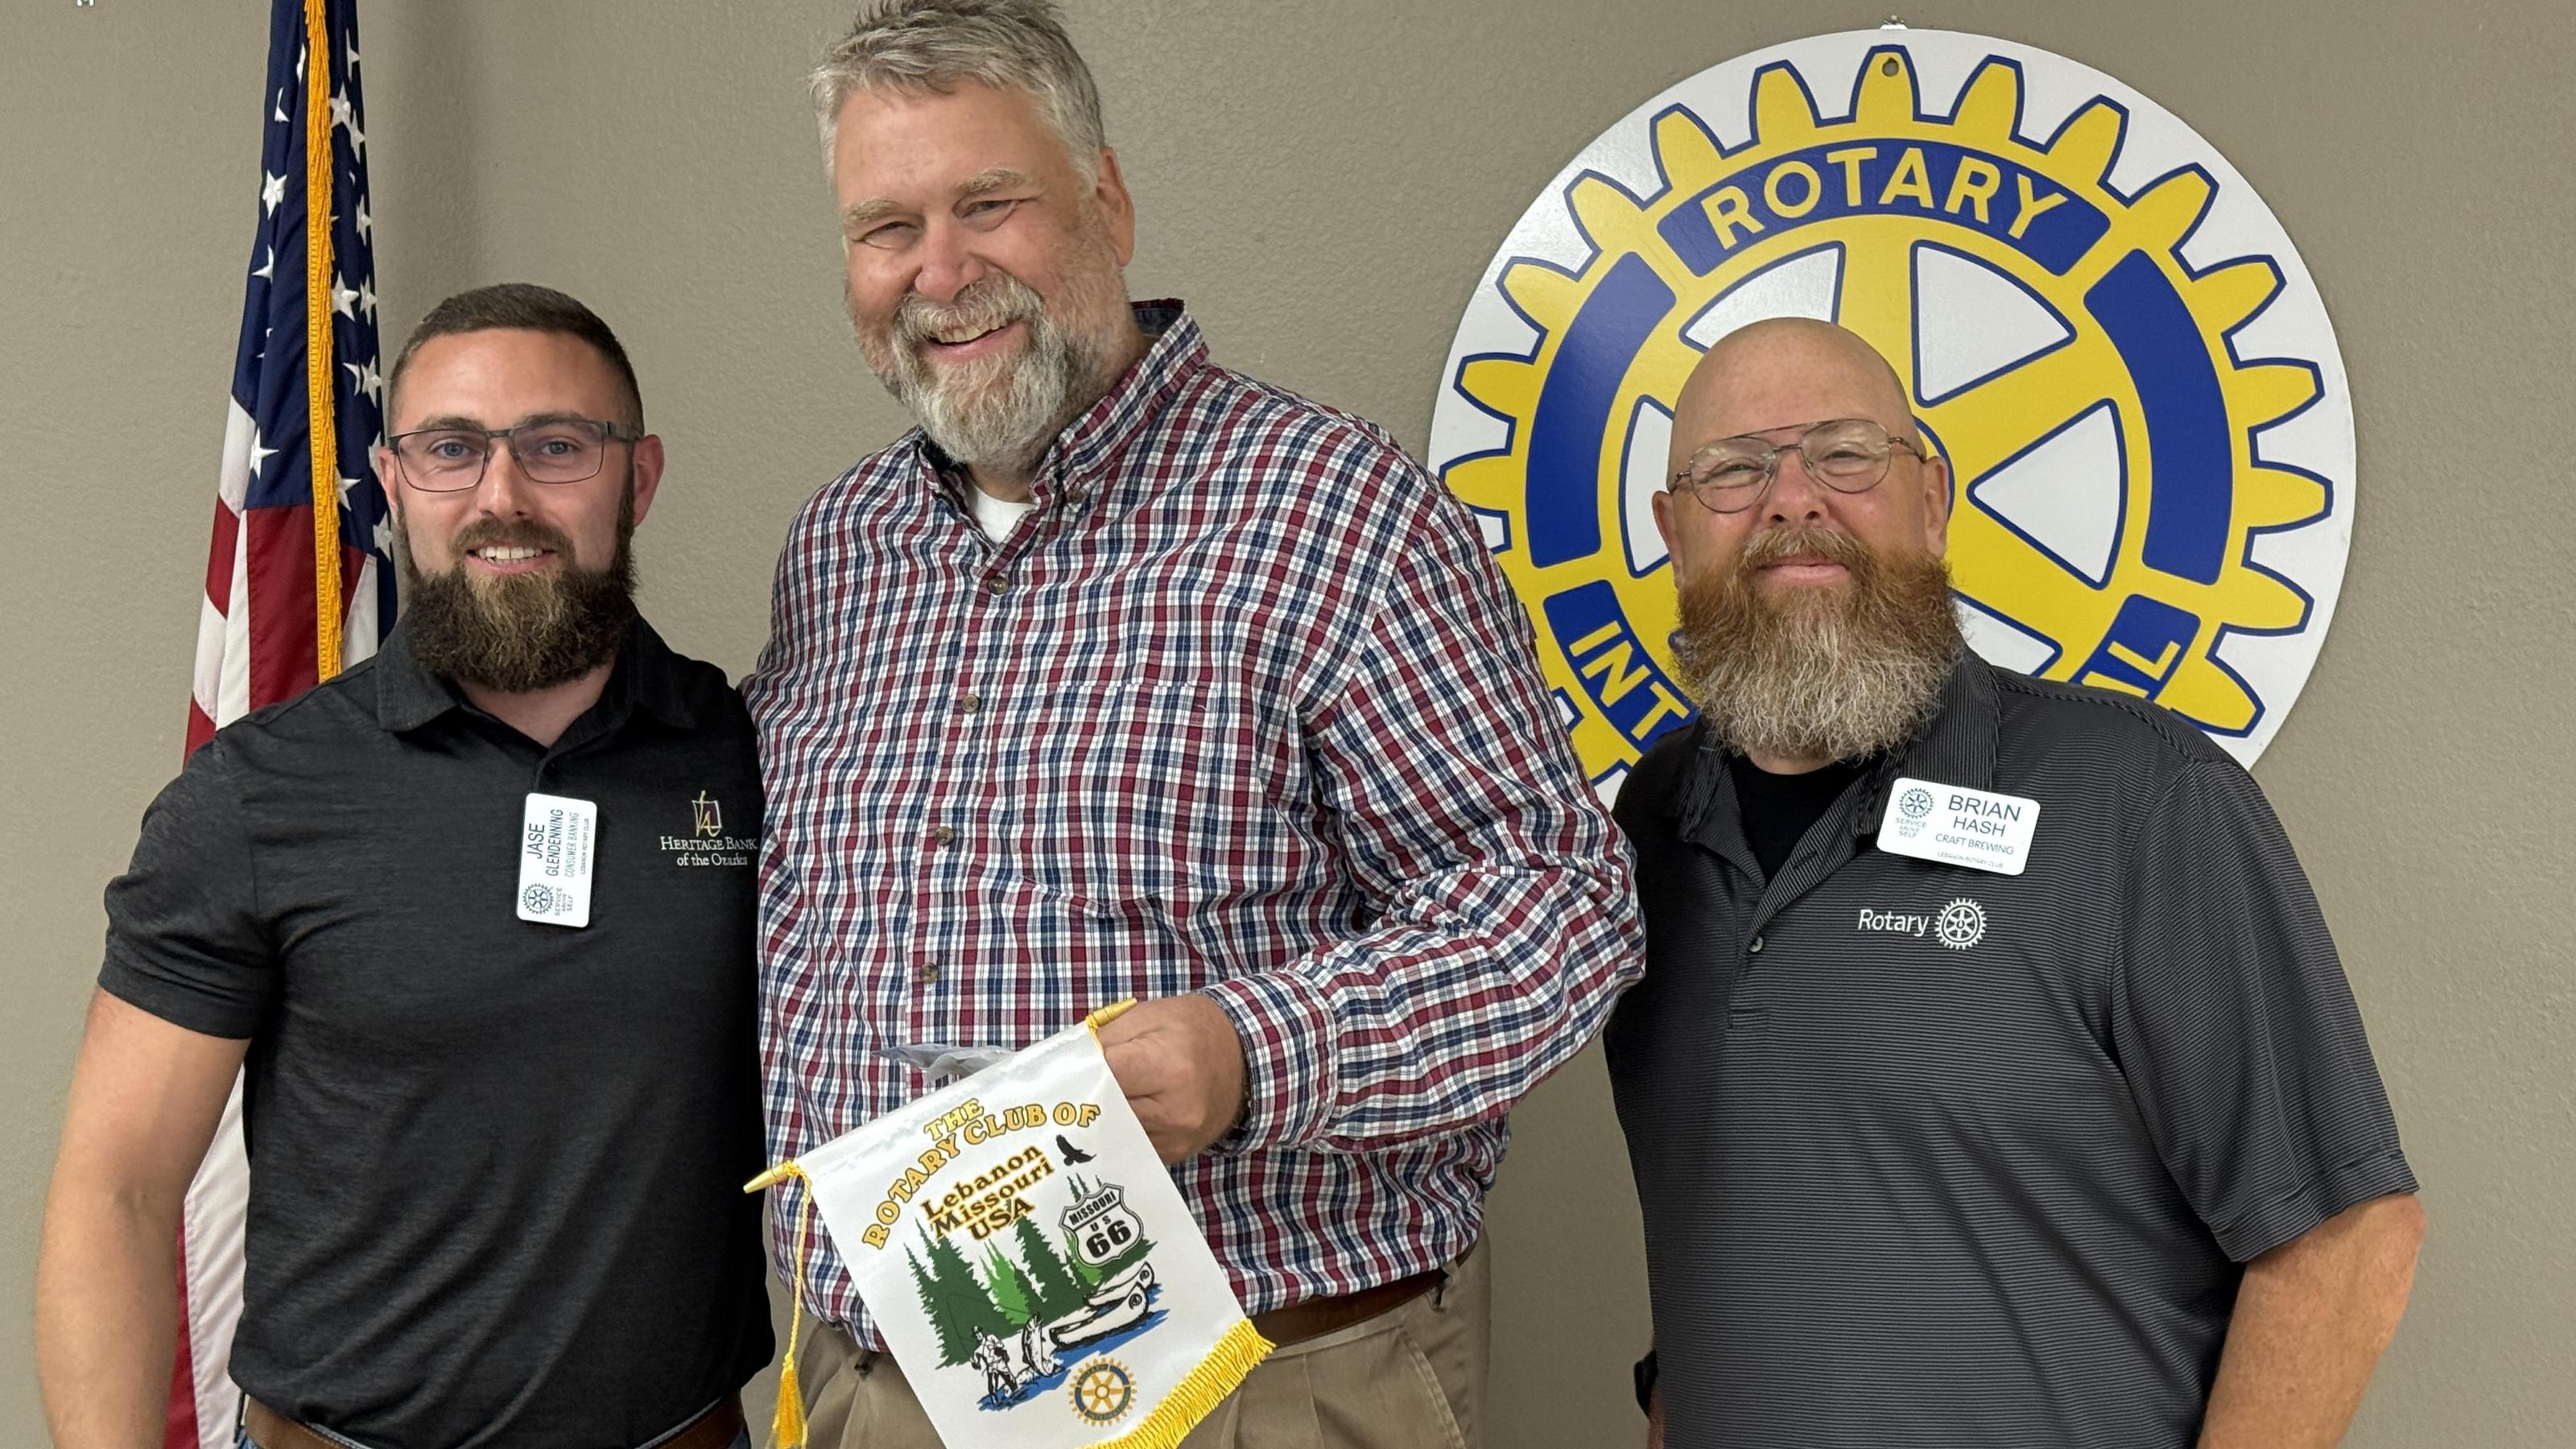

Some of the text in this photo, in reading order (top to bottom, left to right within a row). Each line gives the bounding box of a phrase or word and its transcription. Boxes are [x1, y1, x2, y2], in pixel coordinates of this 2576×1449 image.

[1701, 147, 2069, 250] ROTARY
[1948, 794, 2021, 822] BRIAN
[1953, 815, 2007, 837] HASH
[526, 823, 545, 860] JASE
[546, 809, 564, 877] GLENDENNING
[564, 812, 580, 878] CONSUMER BANKING
[660, 836, 759, 851] HERITAGE BANK
[677, 852, 748, 866] of the Ozarks
[1935, 833, 2014, 856] CRAFT BREWING
[1858, 909, 1930, 938] Rotary
[923, 1097, 985, 1141] THE
[861, 1101, 1101, 1249] ROTARY CLUB OF
[919, 1144, 1044, 1220] Lebanon
[930, 1157, 1056, 1241] Missouri
[1068, 1191, 1117, 1226] MISSOURI
[967, 1196, 1036, 1241] USA
[1086, 1220, 1132, 1258] 66
